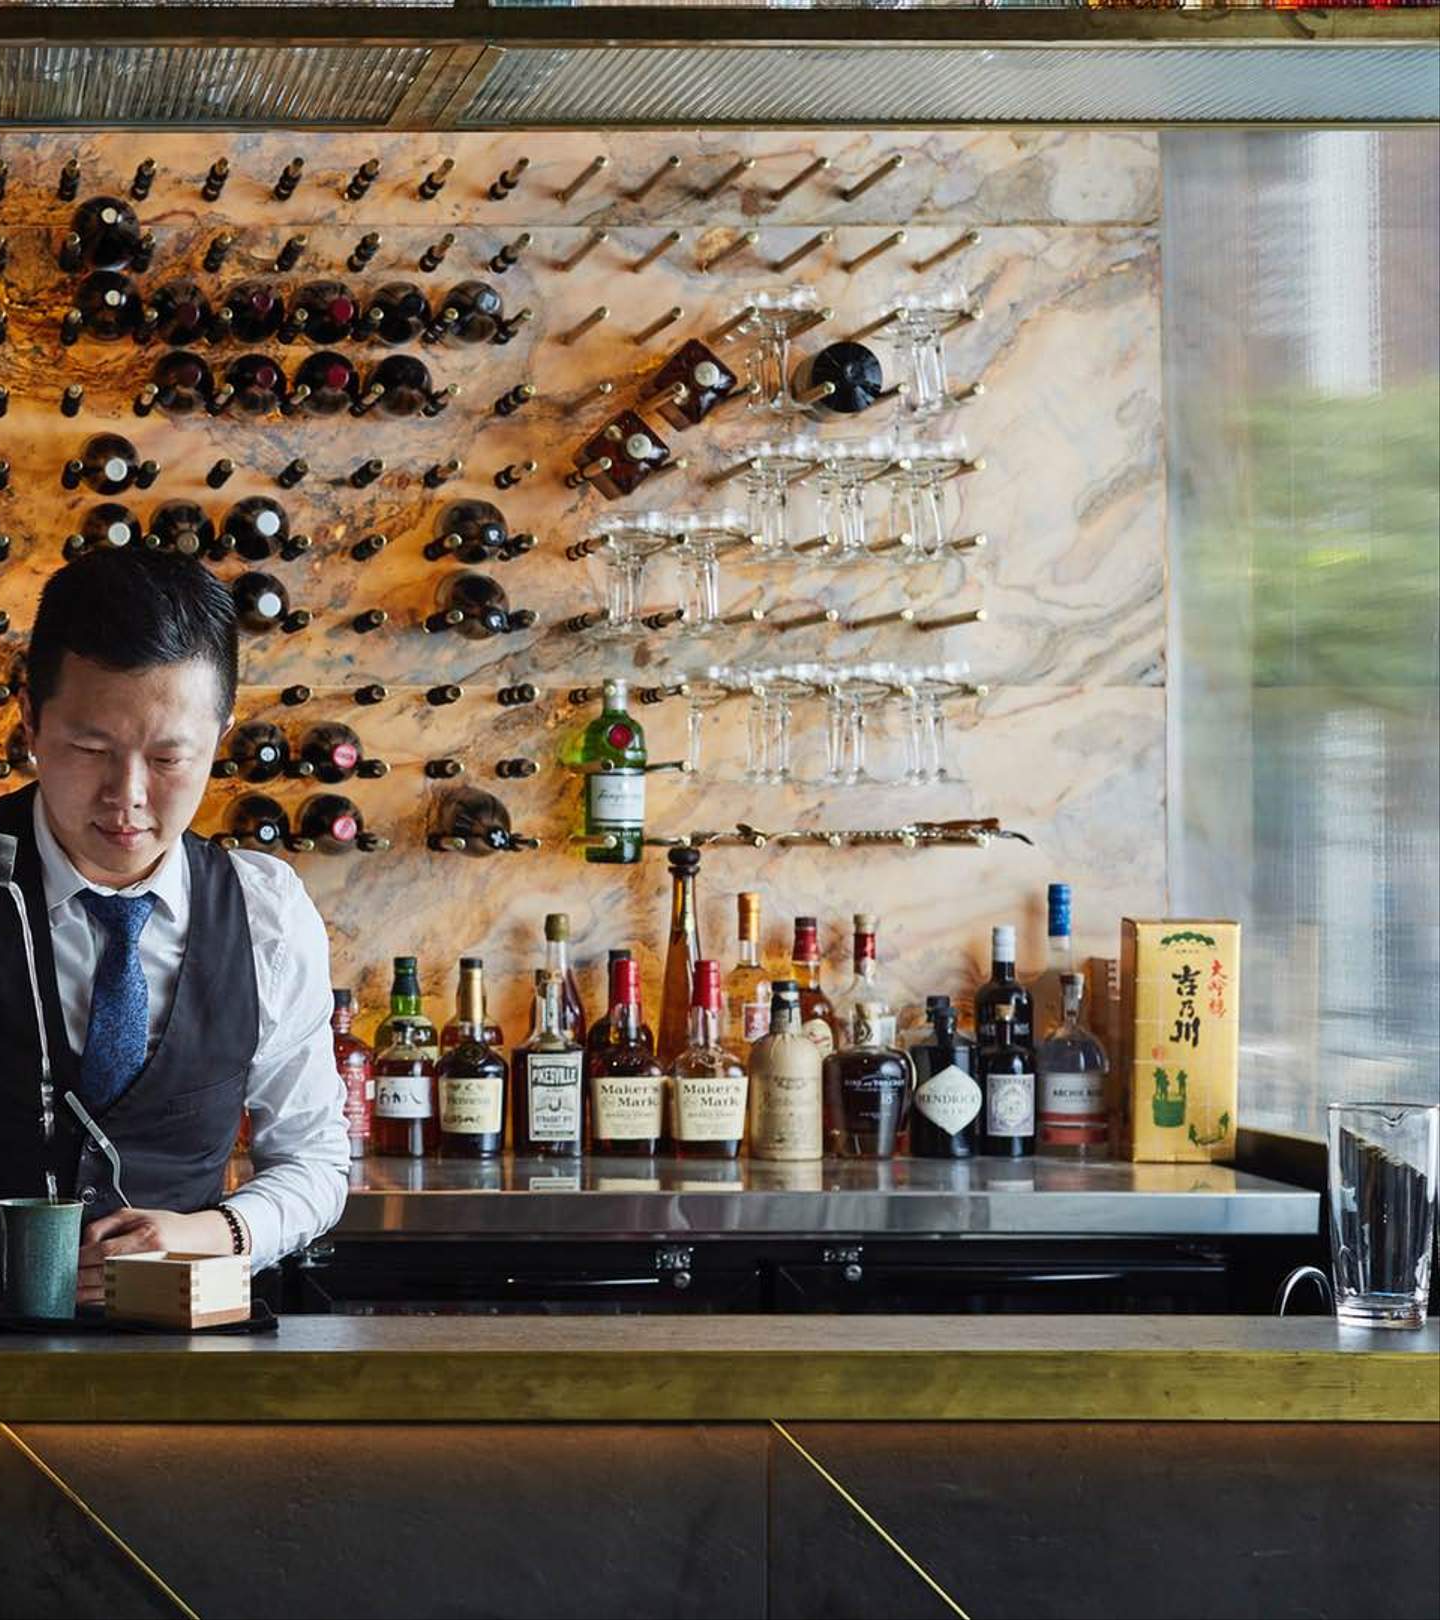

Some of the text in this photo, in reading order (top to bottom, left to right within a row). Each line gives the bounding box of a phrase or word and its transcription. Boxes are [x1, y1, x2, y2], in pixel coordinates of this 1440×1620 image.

[1169, 964, 1201, 1048] 吉乃川
[601, 1084, 659, 1095] Maker's
[683, 1084, 740, 1095] Maker's
[618, 1097, 658, 1107] Mark
[700, 1097, 739, 1107] Mark
